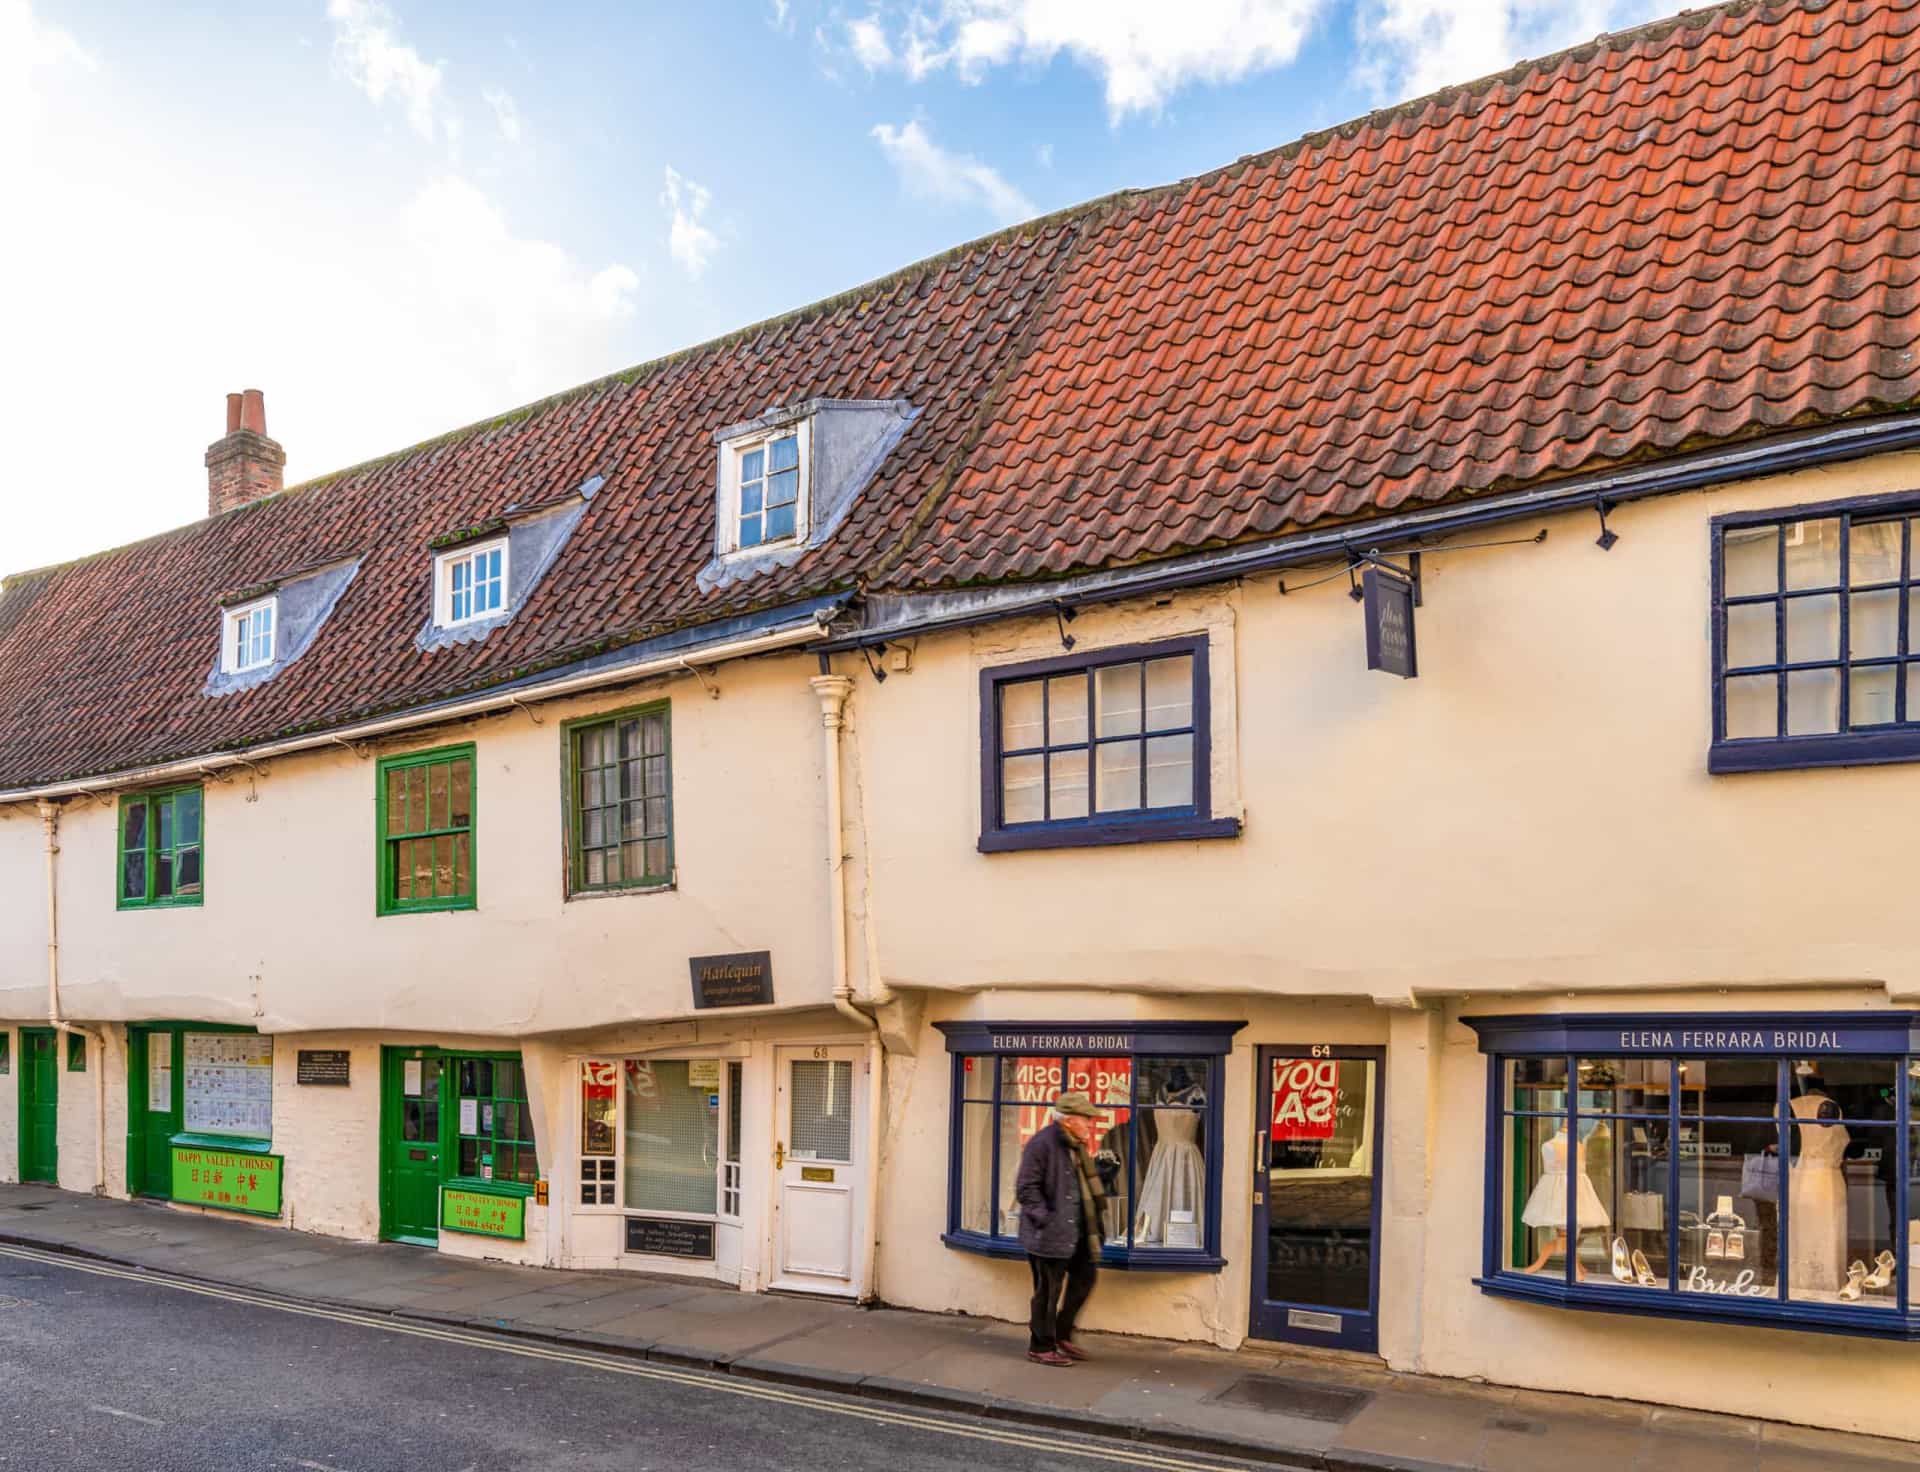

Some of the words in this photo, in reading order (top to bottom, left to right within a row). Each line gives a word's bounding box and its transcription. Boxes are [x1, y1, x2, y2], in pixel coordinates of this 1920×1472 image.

[699, 965, 761, 983] Harlequin
[993, 1036, 1027, 1049] ELENA
[1032, 1036, 1083, 1049] FERRARA
[1088, 1036, 1129, 1049] BRIDAL
[1621, 1032, 1673, 1047] ELENA
[1683, 1032, 1764, 1048] FERRARA
[1774, 1032, 1840, 1048] BRIDAL
[813, 1047, 828, 1058] 68
[1312, 1045, 1330, 1058] 64
[178, 1152, 201, 1165] HAPPY
[206, 1154, 236, 1168] VALLEY
[239, 1157, 274, 1171] CHINESE
[1687, 1265, 1769, 1297] Bride
